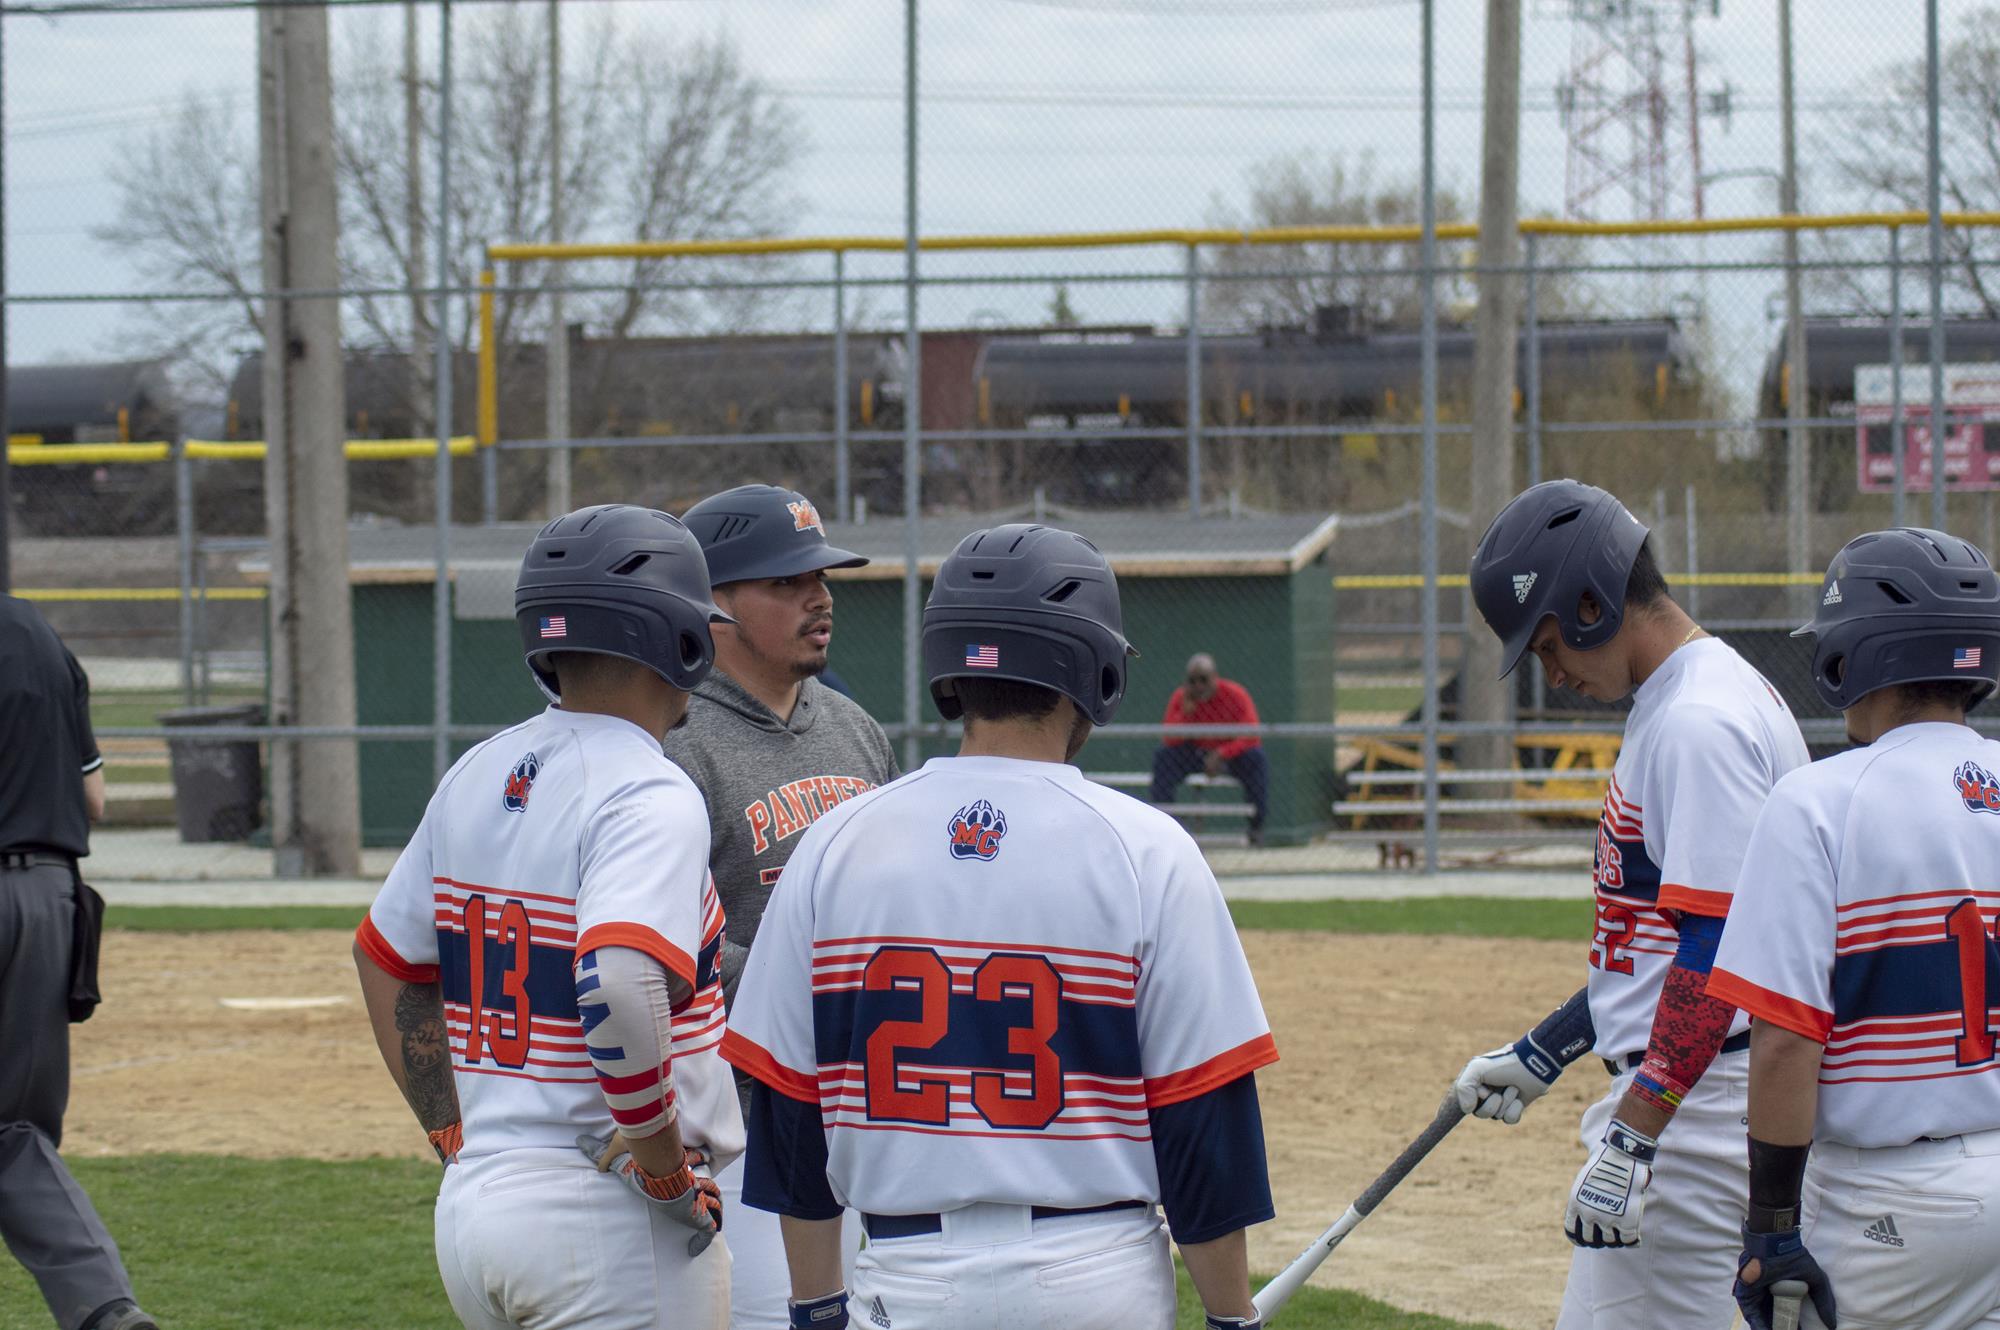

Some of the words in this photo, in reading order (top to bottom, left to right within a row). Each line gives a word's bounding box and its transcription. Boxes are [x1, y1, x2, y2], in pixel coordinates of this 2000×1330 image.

[1518, 571, 1538, 603] adidas
[1959, 779, 2000, 809] MC
[745, 775, 880, 856] PANTHE
[950, 820, 1002, 855] MC
[463, 894, 531, 1070] 13
[1945, 897, 2000, 1068] 1
[862, 945, 1065, 1130] 23
[1581, 1188, 1624, 1212] franklin
[1863, 1228, 1904, 1247] adidas
[869, 1312, 892, 1330] adidas
